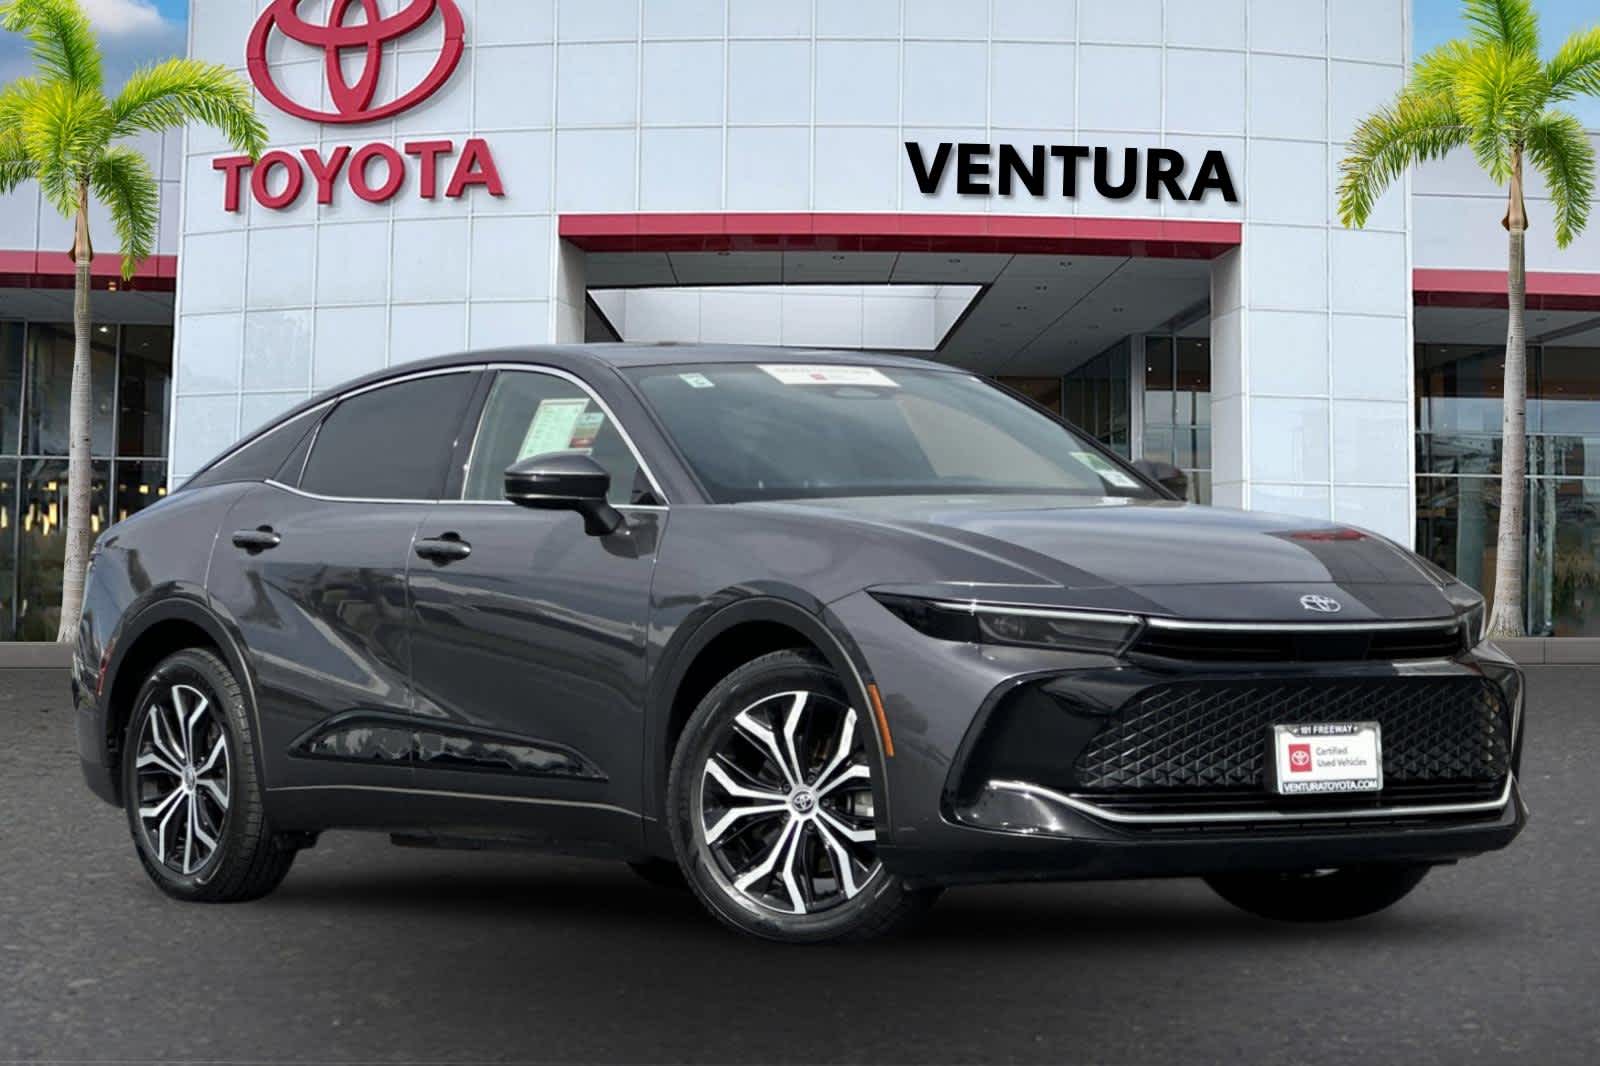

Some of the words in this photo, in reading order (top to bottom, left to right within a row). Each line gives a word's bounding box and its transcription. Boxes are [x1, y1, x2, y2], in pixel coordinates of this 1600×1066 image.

[213, 138, 505, 212] TOYOTA
[904, 142, 1239, 203] VENTURA
[1313, 725, 1353, 734] FREEWAY
[1315, 746, 1348, 756] Certified
[1317, 759, 1337, 768] Used
[1338, 759, 1368, 768] Vehicles
[1283, 780, 1377, 793] VENTURATOYOTA.COM
